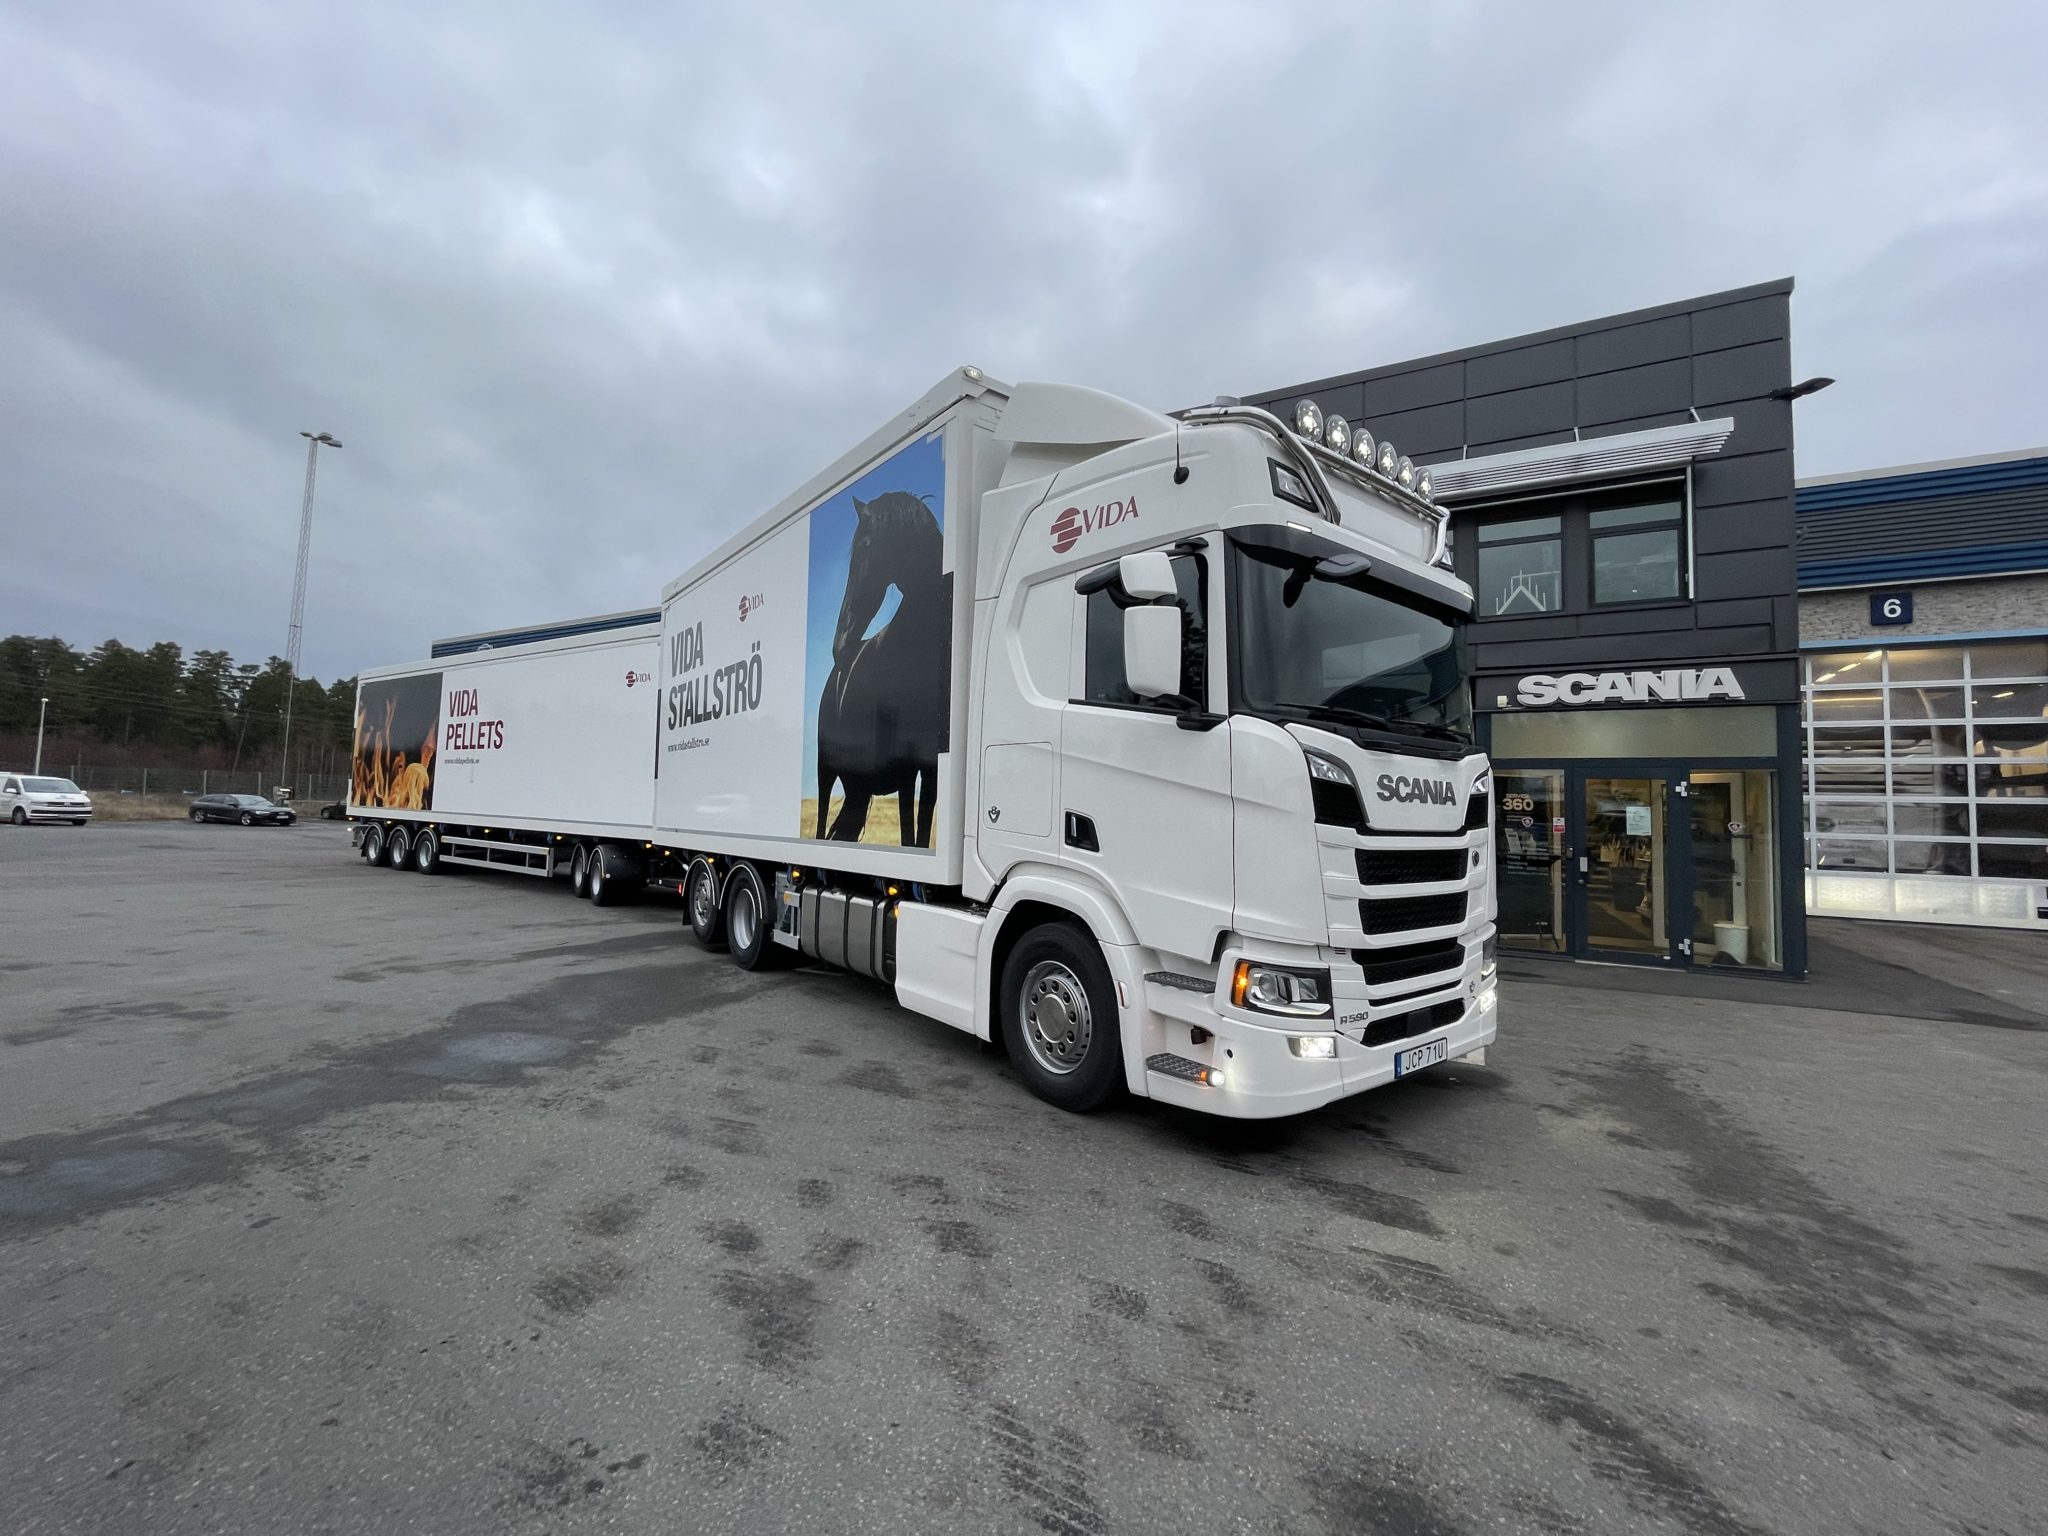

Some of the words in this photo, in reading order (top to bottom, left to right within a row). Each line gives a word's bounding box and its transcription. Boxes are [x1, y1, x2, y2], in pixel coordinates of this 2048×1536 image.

[1082, 496, 1139, 533] VIDA
[747, 593, 764, 611] VIDA
[1883, 598, 1902, 618] 6
[671, 621, 704, 678] VIDA
[635, 673, 651, 683] VIDA
[668, 640, 763, 731] STALLSTRÖ
[1516, 667, 1746, 707] SCANIA
[449, 688, 479, 718] VIDA
[445, 720, 504, 750] PELLETS
[1376, 774, 1457, 807] SCANIA
[1502, 798, 1534, 811] 360
[1405, 1049, 1424, 1071] JCP
[1426, 1042, 1444, 1064] 71U
